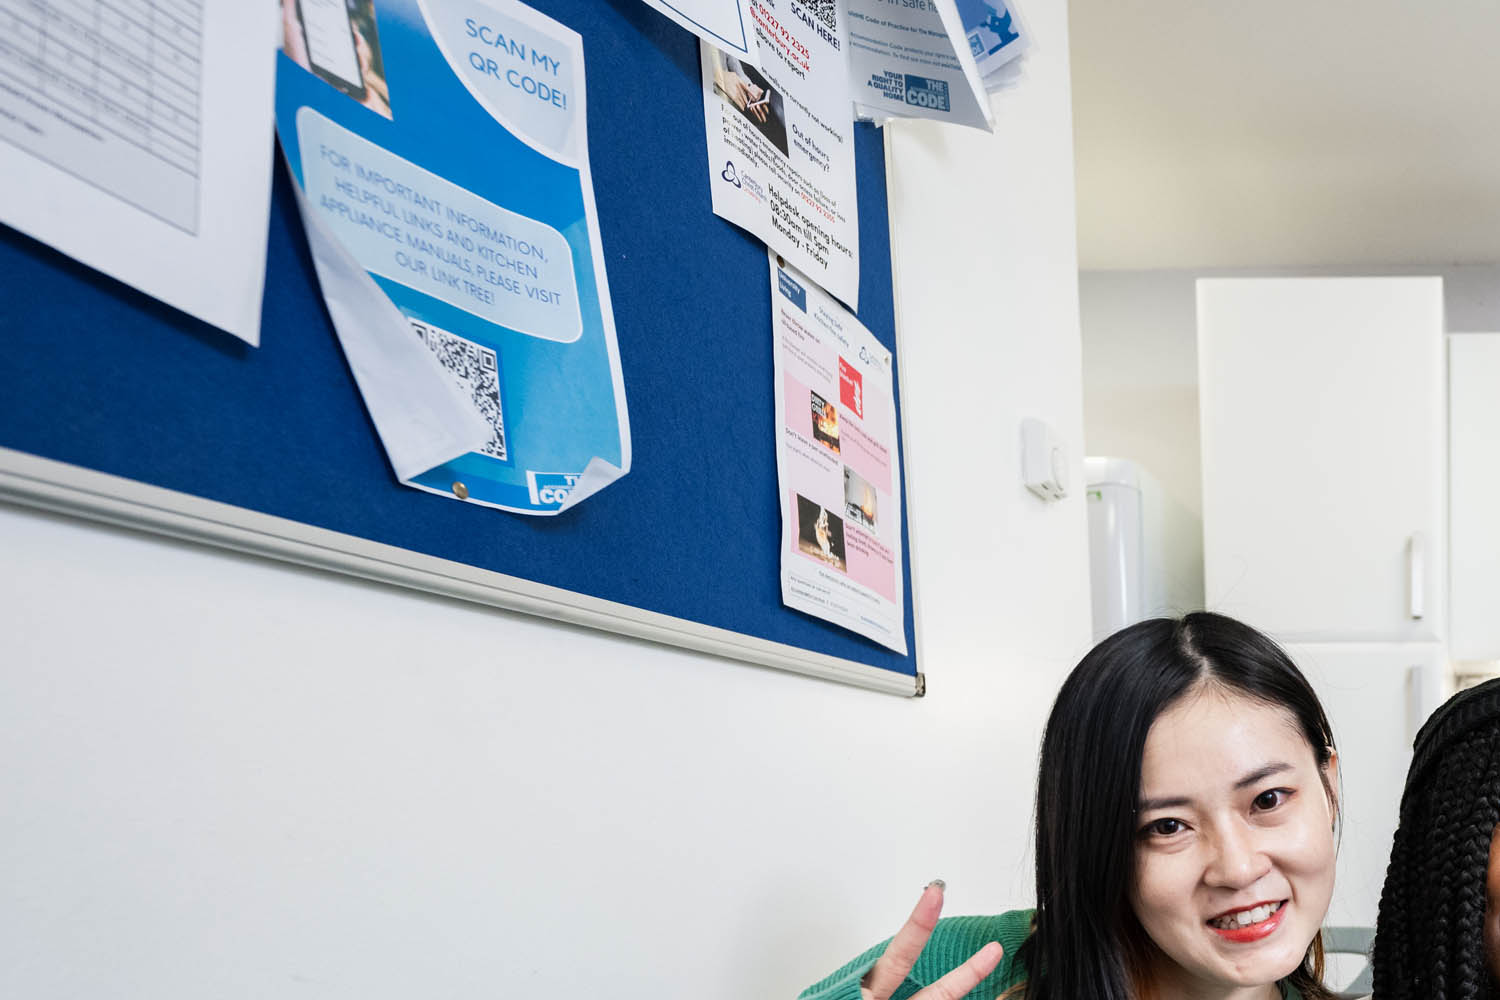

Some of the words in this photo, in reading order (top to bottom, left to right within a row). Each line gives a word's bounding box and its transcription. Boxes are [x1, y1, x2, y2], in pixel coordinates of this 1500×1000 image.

[465, 18, 526, 61] SCAN
[531, 48, 560, 76] MY
[759, 4, 778, 29] 01227
[780, 26, 789, 40] 92
[791, 37, 809, 58] 2325
[790, 2, 814, 30] SCAN
[816, 23, 840, 51] HERE!
[756, 27, 774, 50] above
[776, 47, 782, 58] to
[784, 57, 805, 80] report
[883, 71, 903, 80] YOUR
[469, 52, 500, 80] QR
[506, 69, 566, 110] CODE!
[872, 74, 893, 86] RIGHT
[894, 80, 904, 88] TO
[873, 82, 904, 94] QUALITY
[907, 89, 946, 110] CODE
[926, 79, 944, 92] THE
[792, 124, 803, 139] Out
[811, 140, 829, 161] hours
[793, 139, 829, 171] emergency?
[320, 144, 351, 172] FOR
[354, 162, 441, 216] IMPORTANT
[446, 206, 549, 264] INFORMATION,
[334, 175, 401, 220] HELPFUL
[402, 208, 443, 239] LINKS
[447, 229, 475, 253] AND
[478, 244, 537, 279] KITCHEN
[768, 184, 798, 216] Helpdesk
[801, 214, 829, 245] opening
[770, 200, 801, 233] 08:30am
[803, 227, 812, 241] till
[813, 235, 828, 255] 5pm
[320, 192, 402, 243] APPLIANCE
[476, 264, 521, 296] PLEASE
[525, 283, 561, 306] VISIT
[772, 216, 799, 247] Monday
[806, 243, 827, 271] Friday
[394, 250, 428, 276] OUR
[431, 264, 460, 290] LINK
[463, 278, 496, 306] TREE!
[778, 272, 800, 295] University
[540, 488, 568, 504] CO
